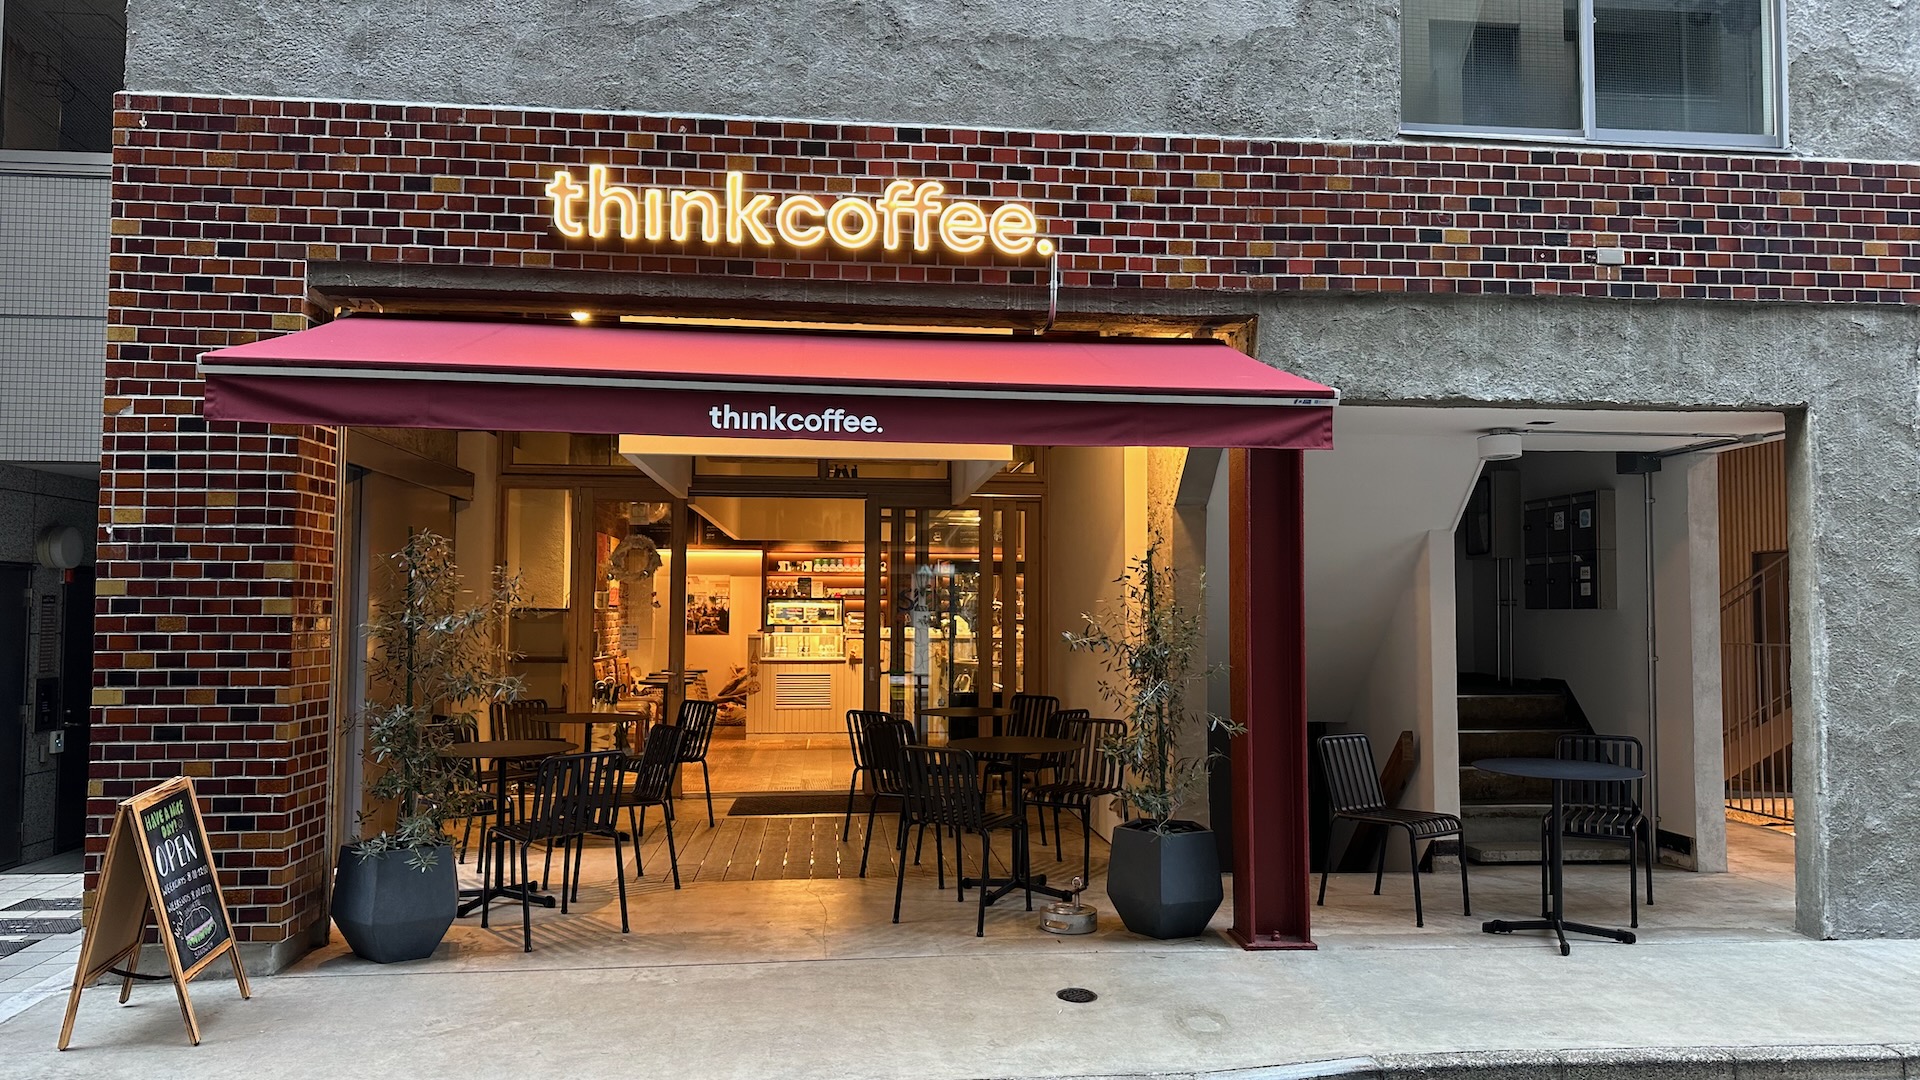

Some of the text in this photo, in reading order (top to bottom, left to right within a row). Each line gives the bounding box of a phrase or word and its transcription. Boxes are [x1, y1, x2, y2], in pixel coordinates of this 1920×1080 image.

[545, 163, 1055, 255] thinkcoffee.
[708, 404, 884, 433] thinkcoffee.
[144, 809, 164, 831] HAVE
[163, 806, 170, 821] A
[161, 819, 178, 838] DAY!
[155, 830, 197, 877] OPEN
[161, 876, 187, 896] WEEKDAYS
